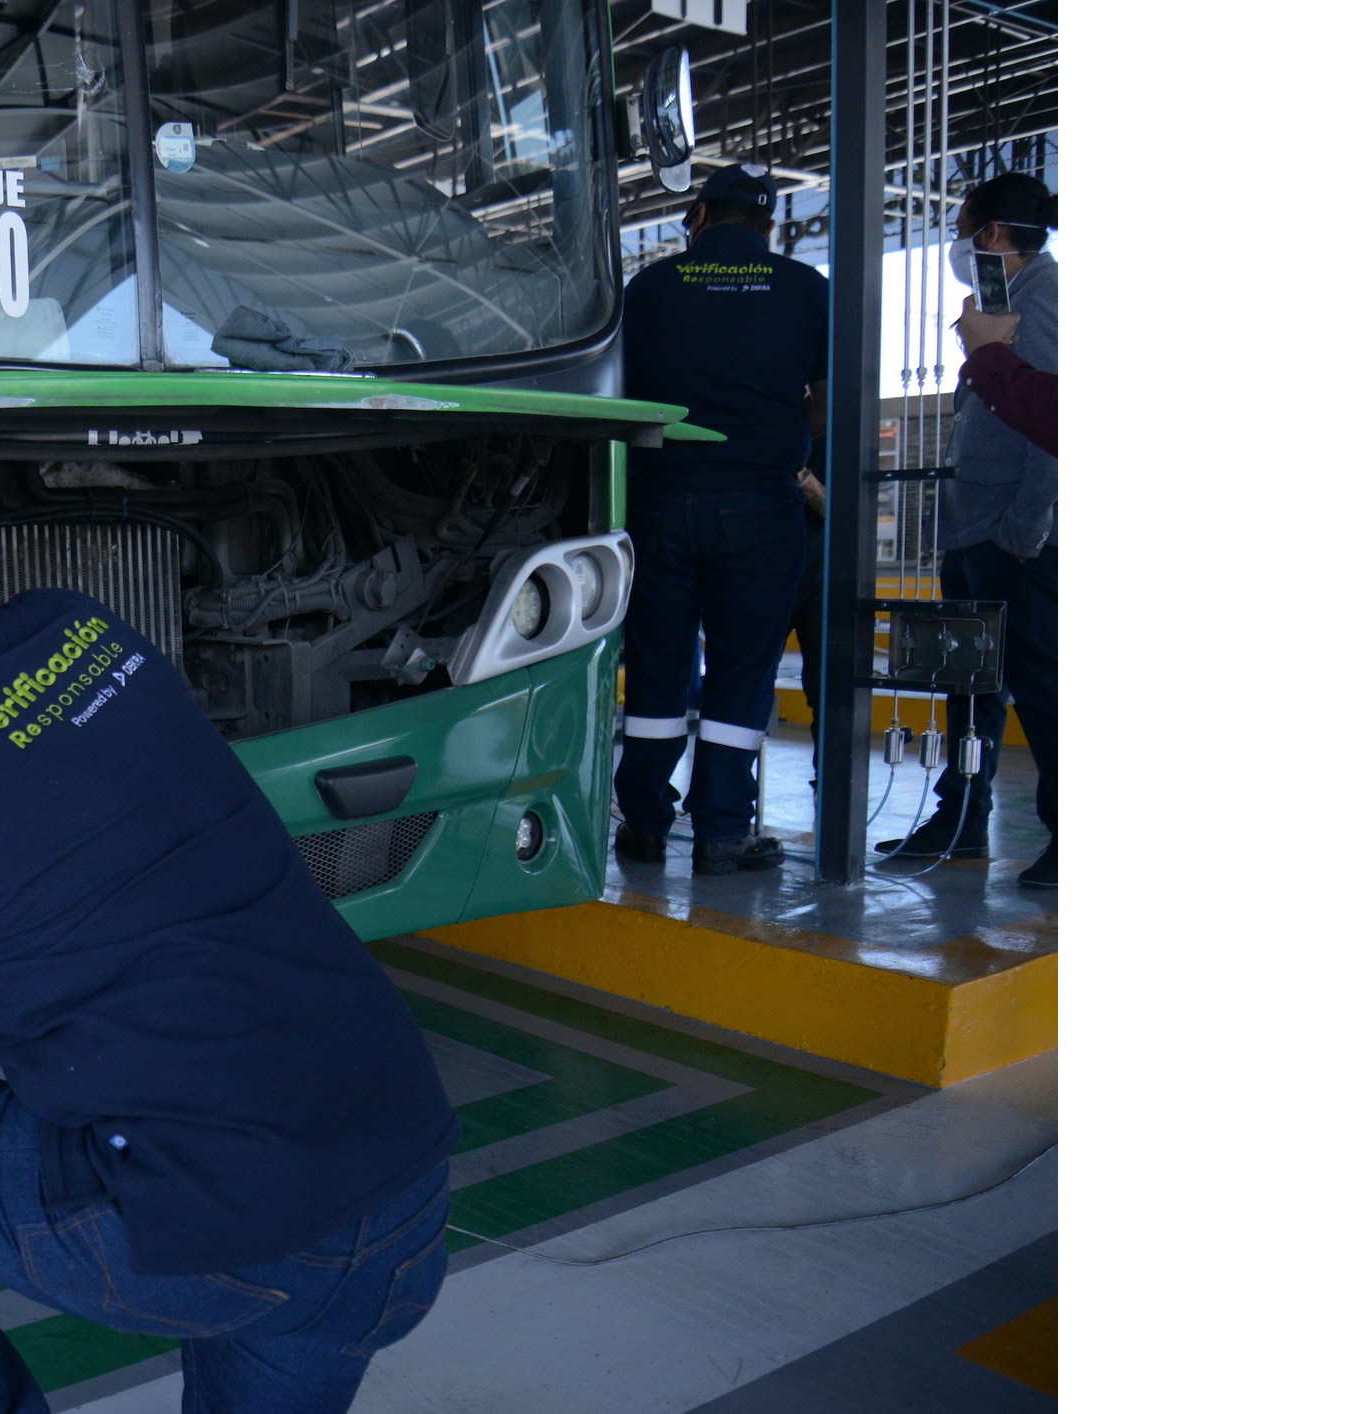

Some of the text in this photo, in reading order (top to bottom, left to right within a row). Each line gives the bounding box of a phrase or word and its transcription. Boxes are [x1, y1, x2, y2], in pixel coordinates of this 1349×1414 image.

[676, 261, 773, 275] Verificación
[682, 275, 766, 284] Responsable
[8, 642, 124, 749] Responsable
[71, 652, 146, 727] Powered by DEKRA
